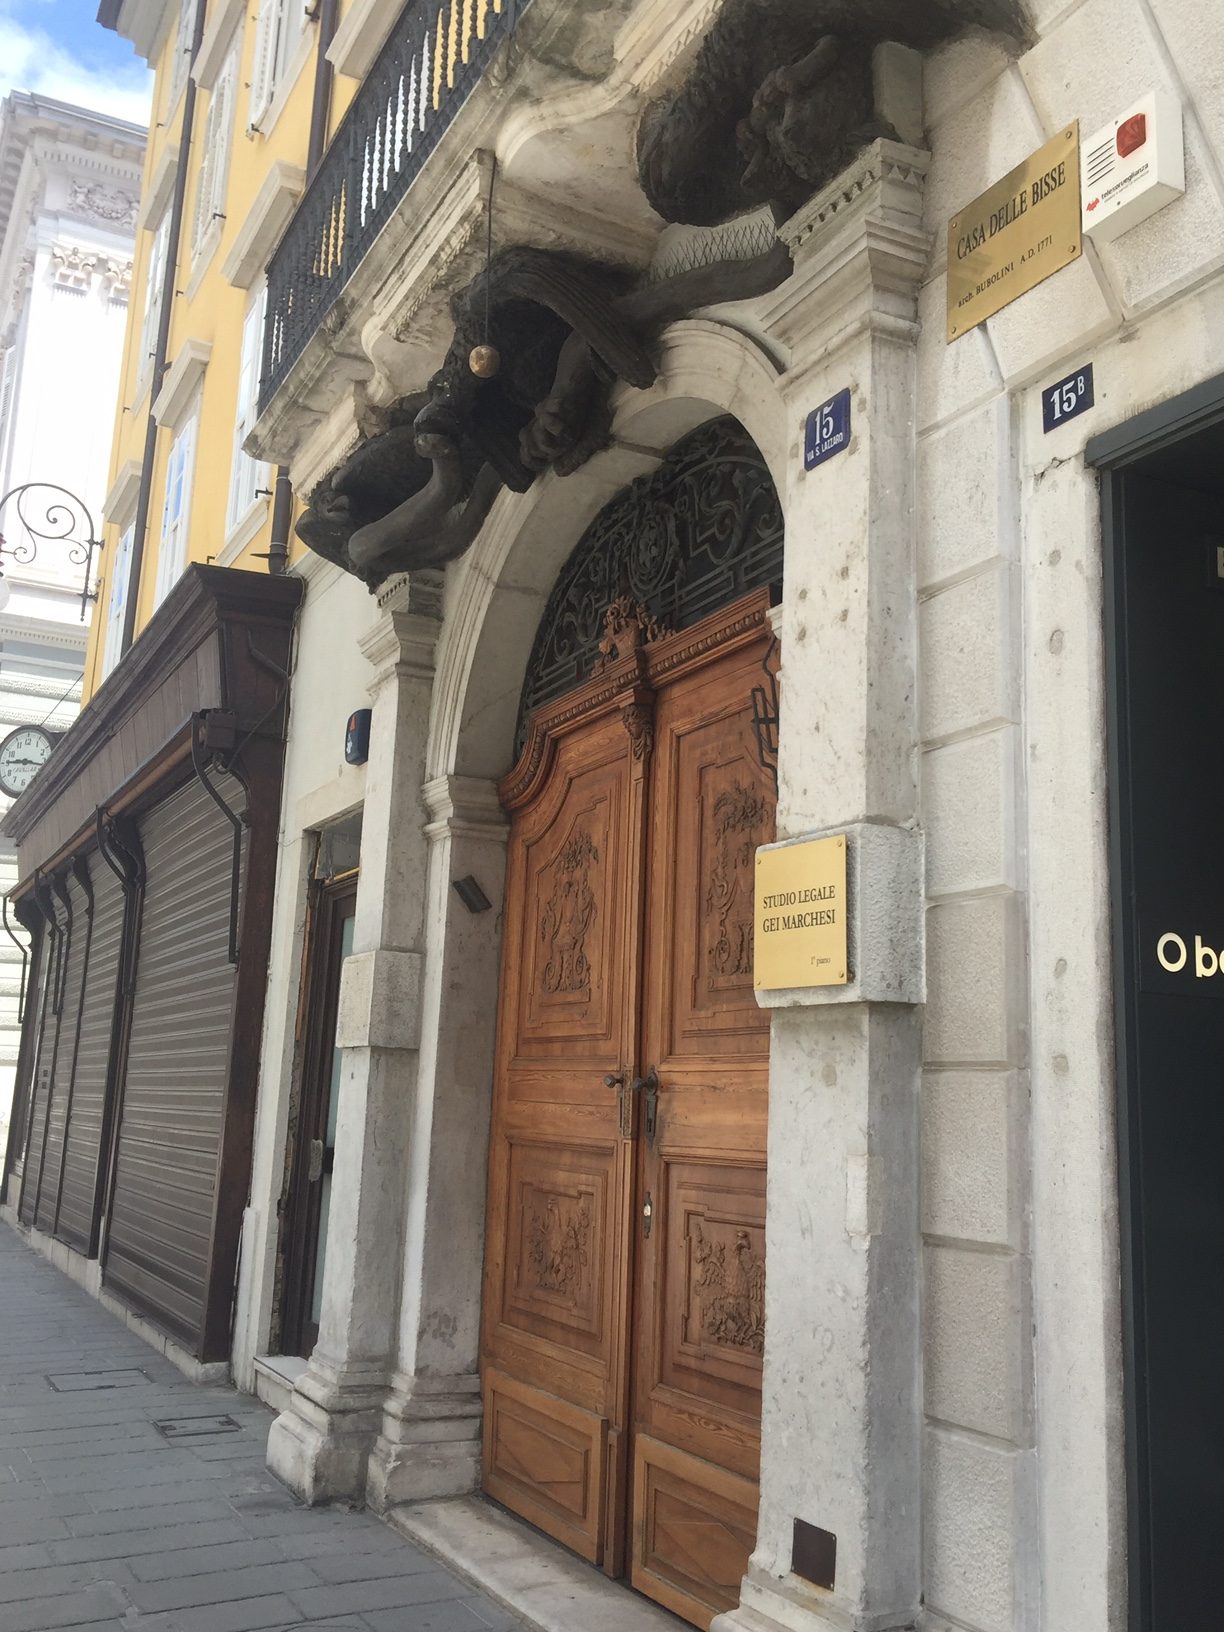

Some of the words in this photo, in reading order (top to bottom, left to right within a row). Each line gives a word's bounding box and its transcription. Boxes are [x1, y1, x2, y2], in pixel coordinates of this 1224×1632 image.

[957, 225, 987, 260] CASA
[989, 190, 1028, 238] DELLE
[1031, 161, 1066, 206] BISSE
[975, 261, 1015, 295] BUBOLINI
[1037, 235, 1053, 253] 1771
[814, 401, 835, 446] 15
[821, 432, 843, 453] LAZZARO
[763, 891, 797, 909] STUDIO
[798, 885, 836, 904] LEGALE
[762, 917, 779, 933] GEI
[781, 909, 836, 931] MARCHESI
[1194, 935, 1224, 978] b
